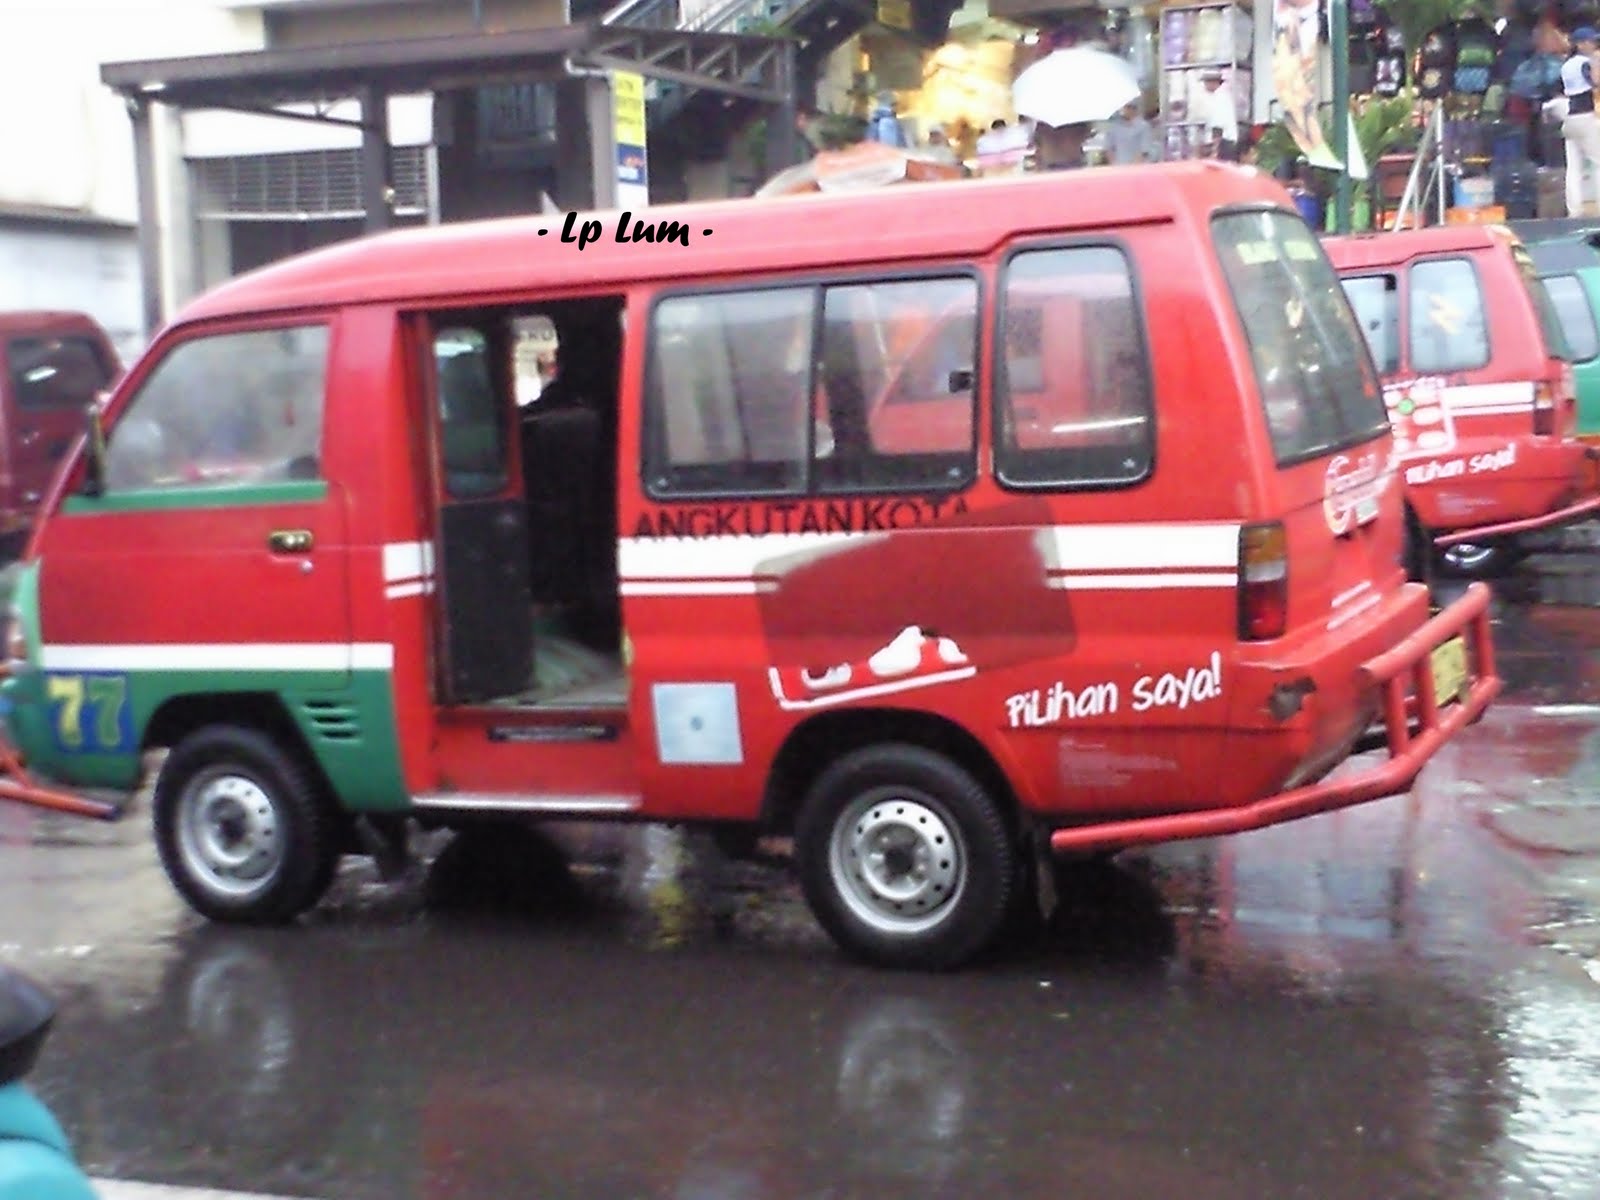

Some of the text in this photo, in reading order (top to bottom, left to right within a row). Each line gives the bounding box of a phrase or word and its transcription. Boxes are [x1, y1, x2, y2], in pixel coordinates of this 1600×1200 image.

[634, 500, 857, 541] ANGKUTAN
[47, 675, 126, 748] 77
[1131, 650, 1222, 712] saya!
